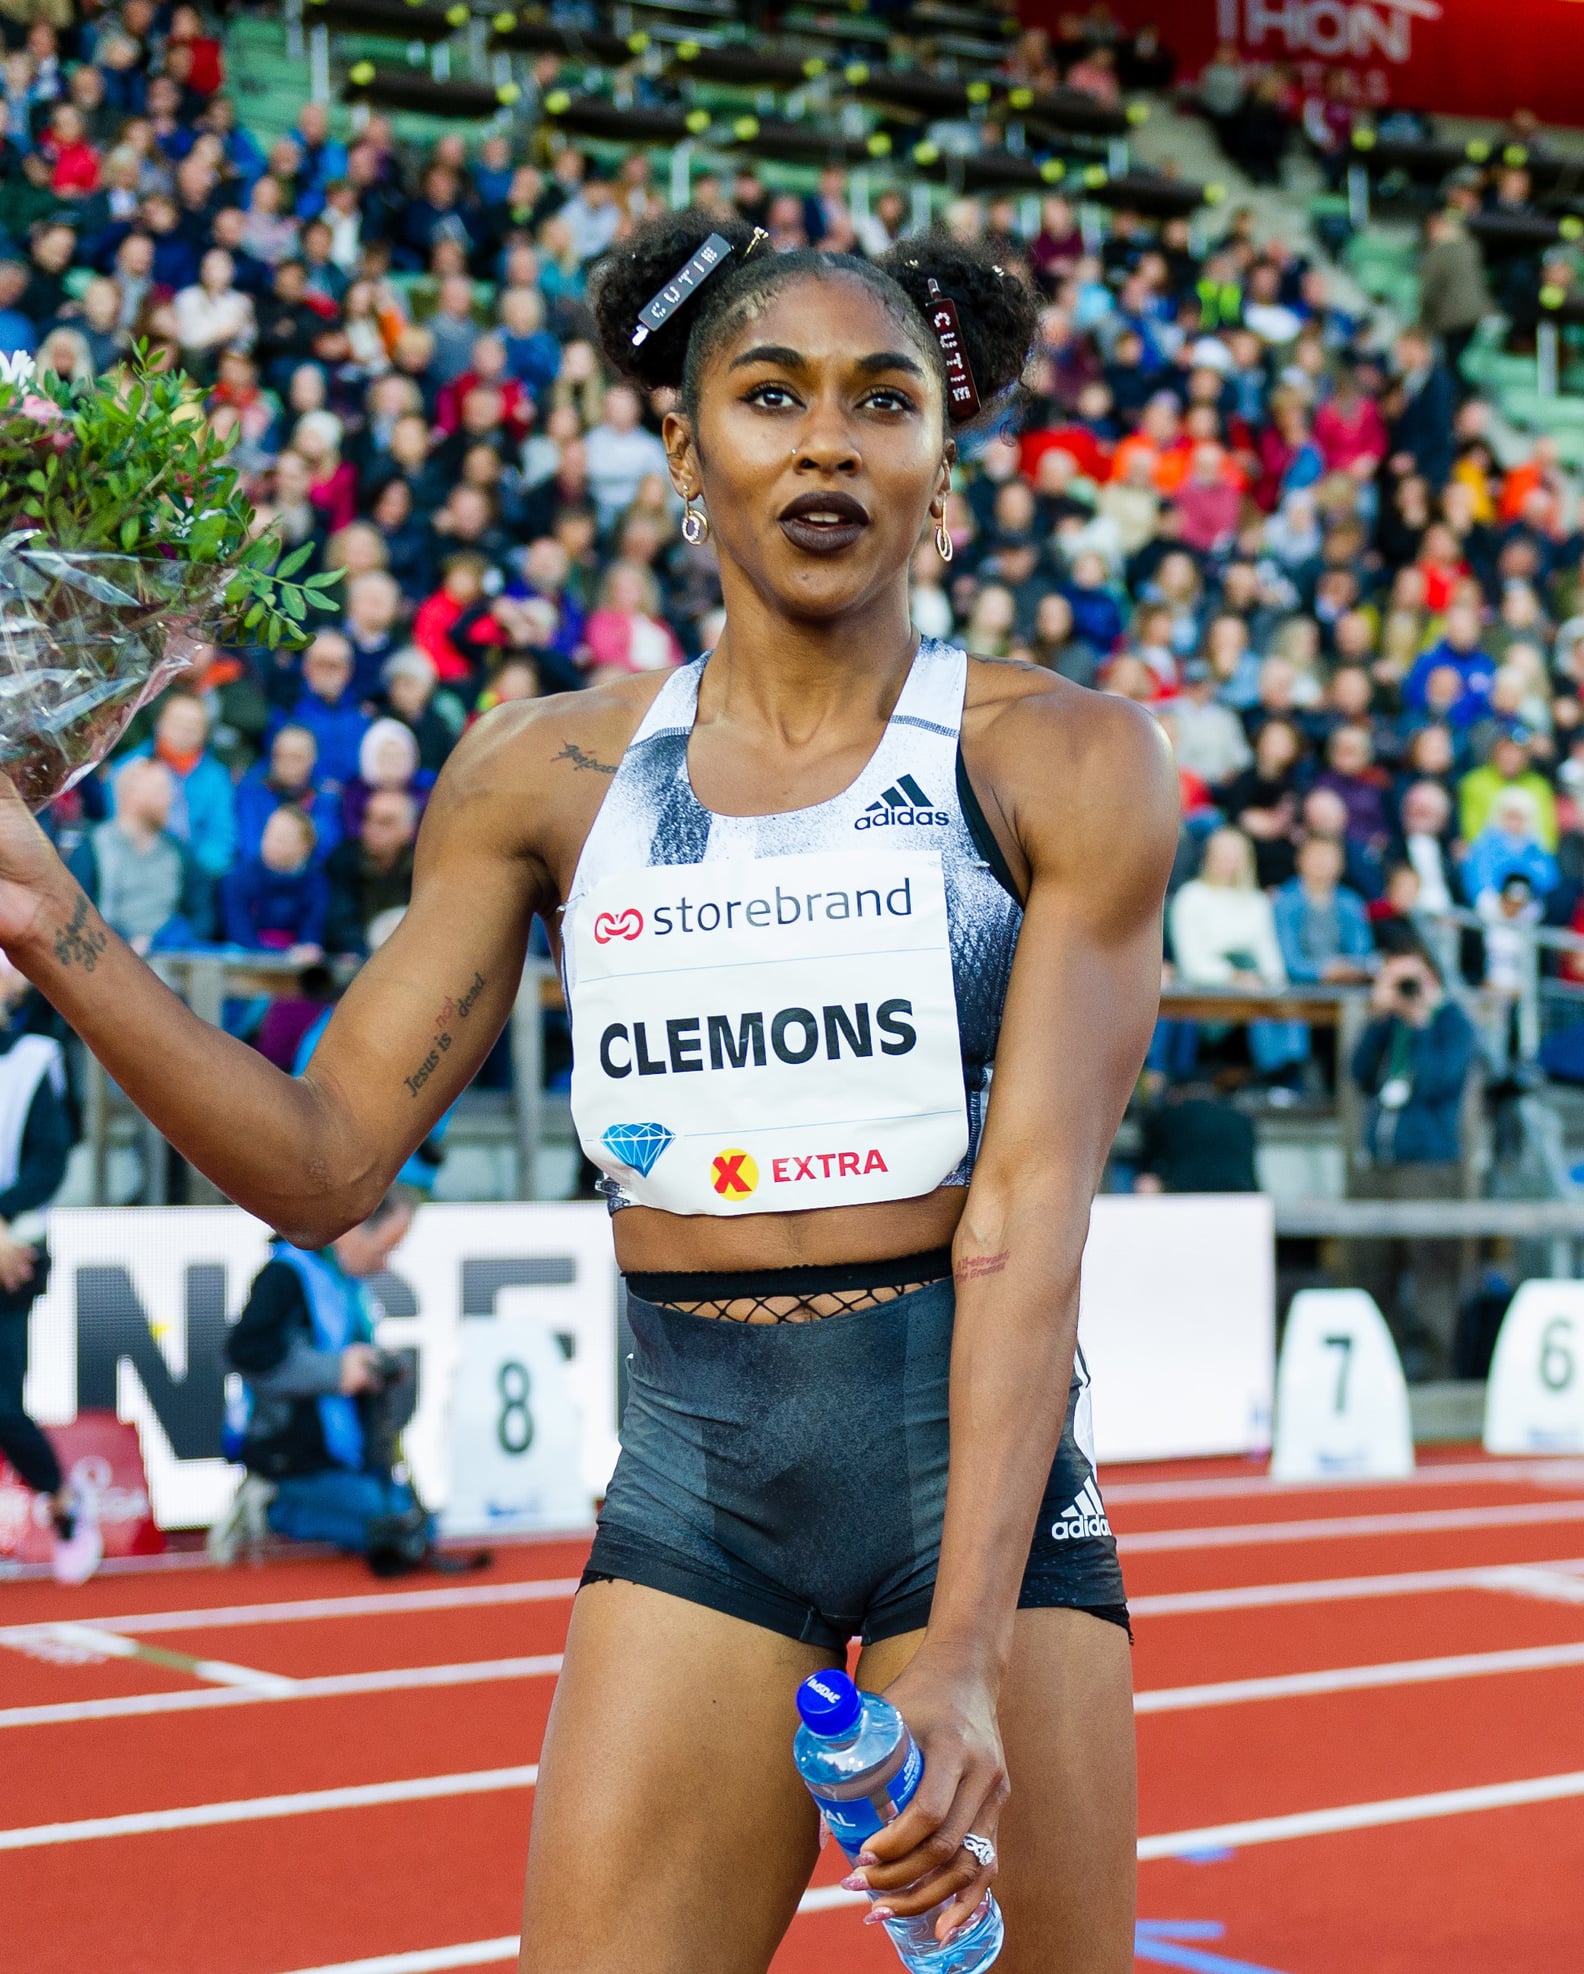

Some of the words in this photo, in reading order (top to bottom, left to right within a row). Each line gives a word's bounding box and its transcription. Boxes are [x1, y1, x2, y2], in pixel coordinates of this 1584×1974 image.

[651, 246, 718, 318] CUTIE
[933, 312, 971, 402] CUTIE
[854, 805, 949, 831] adidas
[653, 878, 912, 936] storebrand
[404, 1050, 440, 1097] Jesus
[434, 1032, 452, 1051] is
[458, 972, 485, 1017] dead
[599, 998, 918, 1080] CLEMONS
[772, 1149, 888, 1184] EXTRA
[1323, 1334, 1354, 1414] 7
[1540, 1316, 1573, 1392] 6
[498, 1360, 534, 1455] 8
[1051, 1514, 1113, 1540] adida
